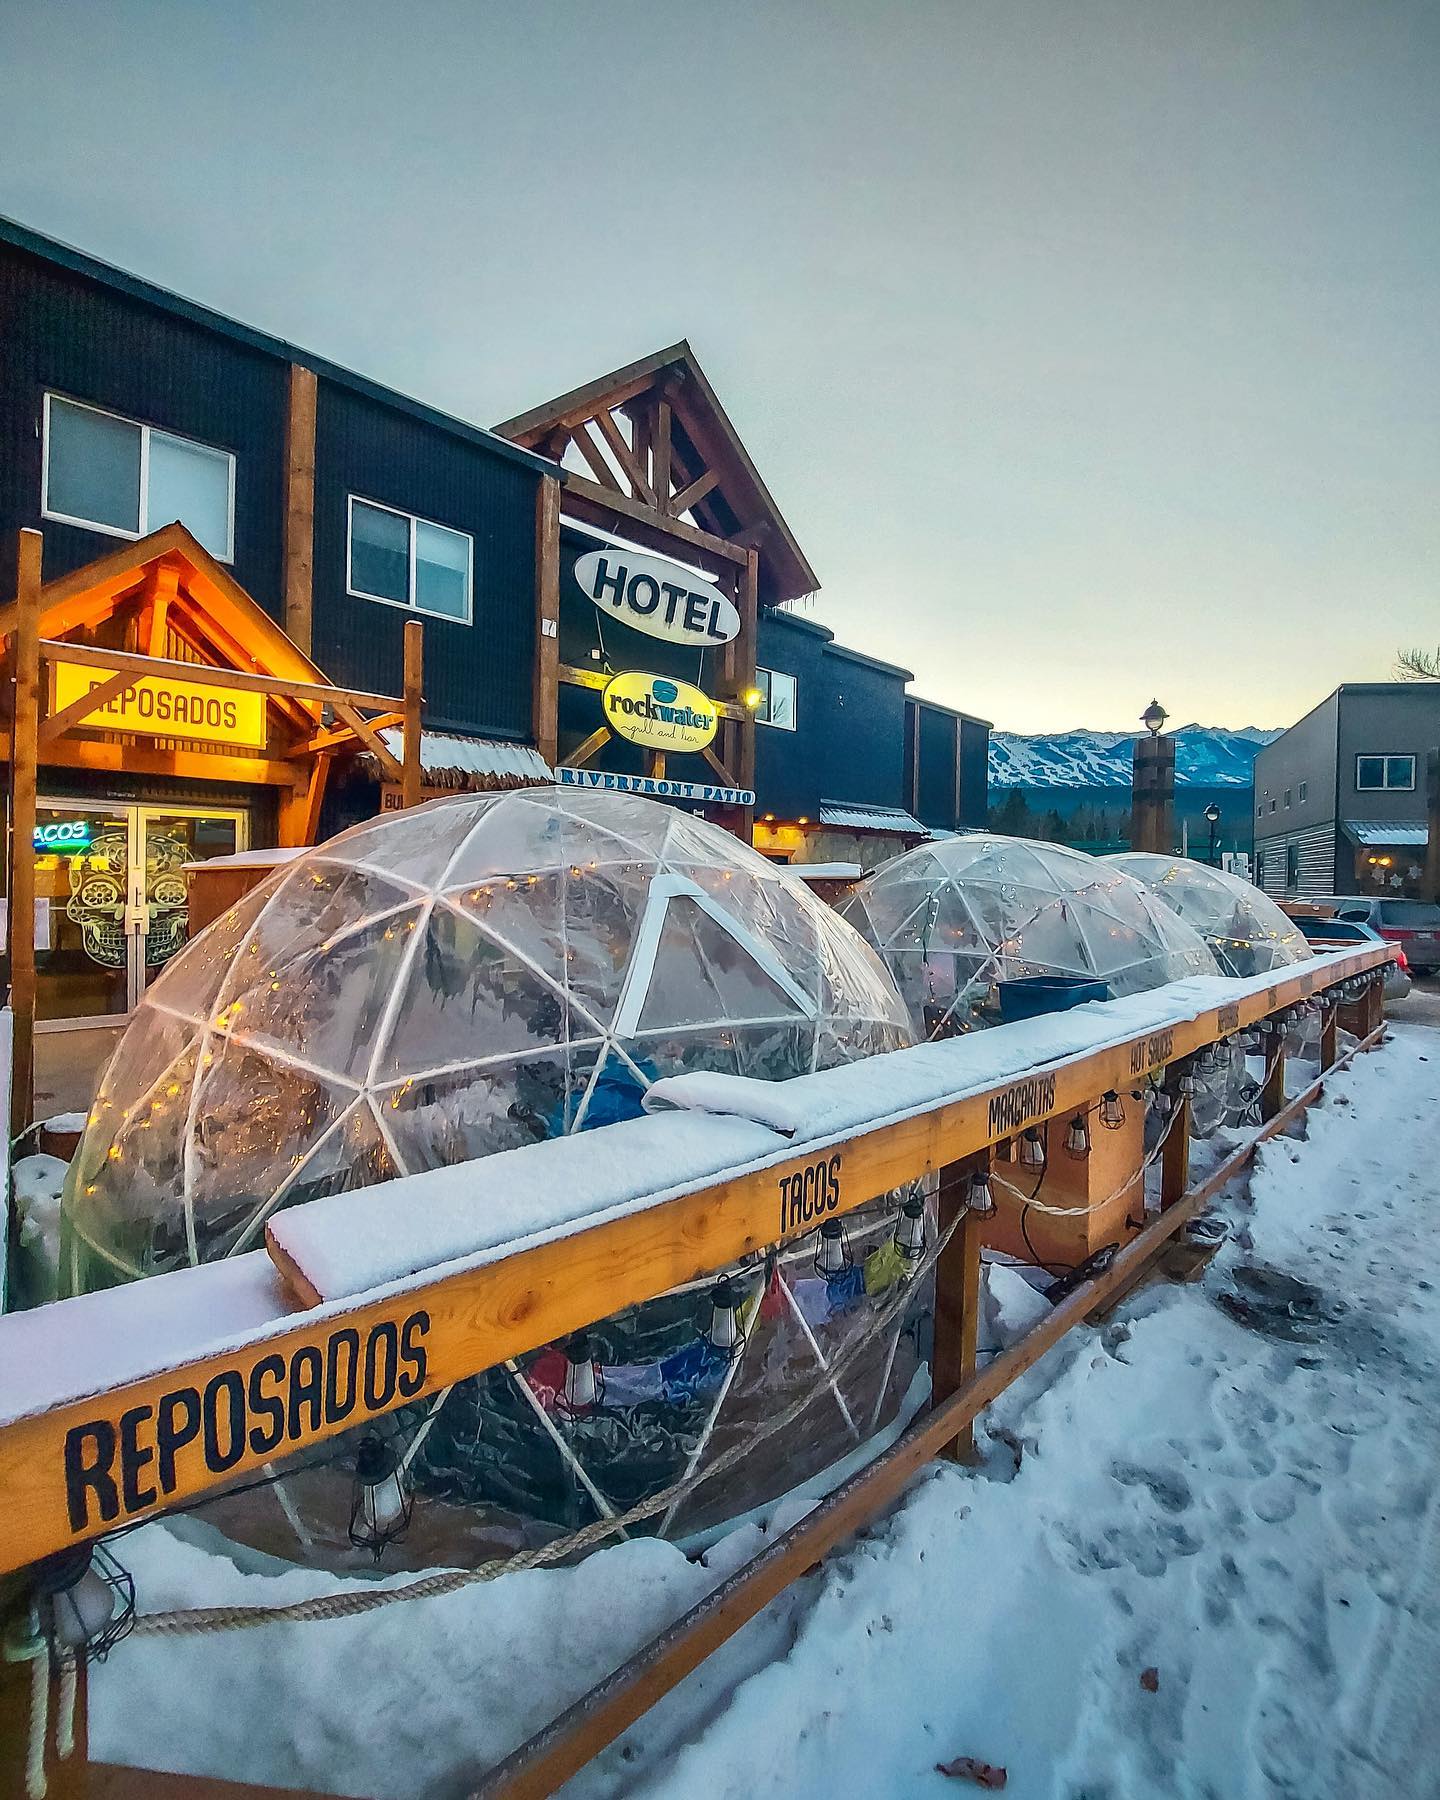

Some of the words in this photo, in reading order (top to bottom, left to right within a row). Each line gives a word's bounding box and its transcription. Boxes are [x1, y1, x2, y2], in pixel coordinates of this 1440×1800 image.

[593, 557, 728, 641] HOTEL
[609, 694, 714, 731] rockwater
[657, 724, 677, 740] and
[560, 768, 694, 797] RIVERFRONT
[702, 787, 752, 804] PATIO
[32, 820, 89, 843] ACOS
[987, 1072, 1056, 1139] MARGARITAS
[777, 1153, 842, 1234] TACOS
[64, 1310, 431, 1534] REPOSADOS
